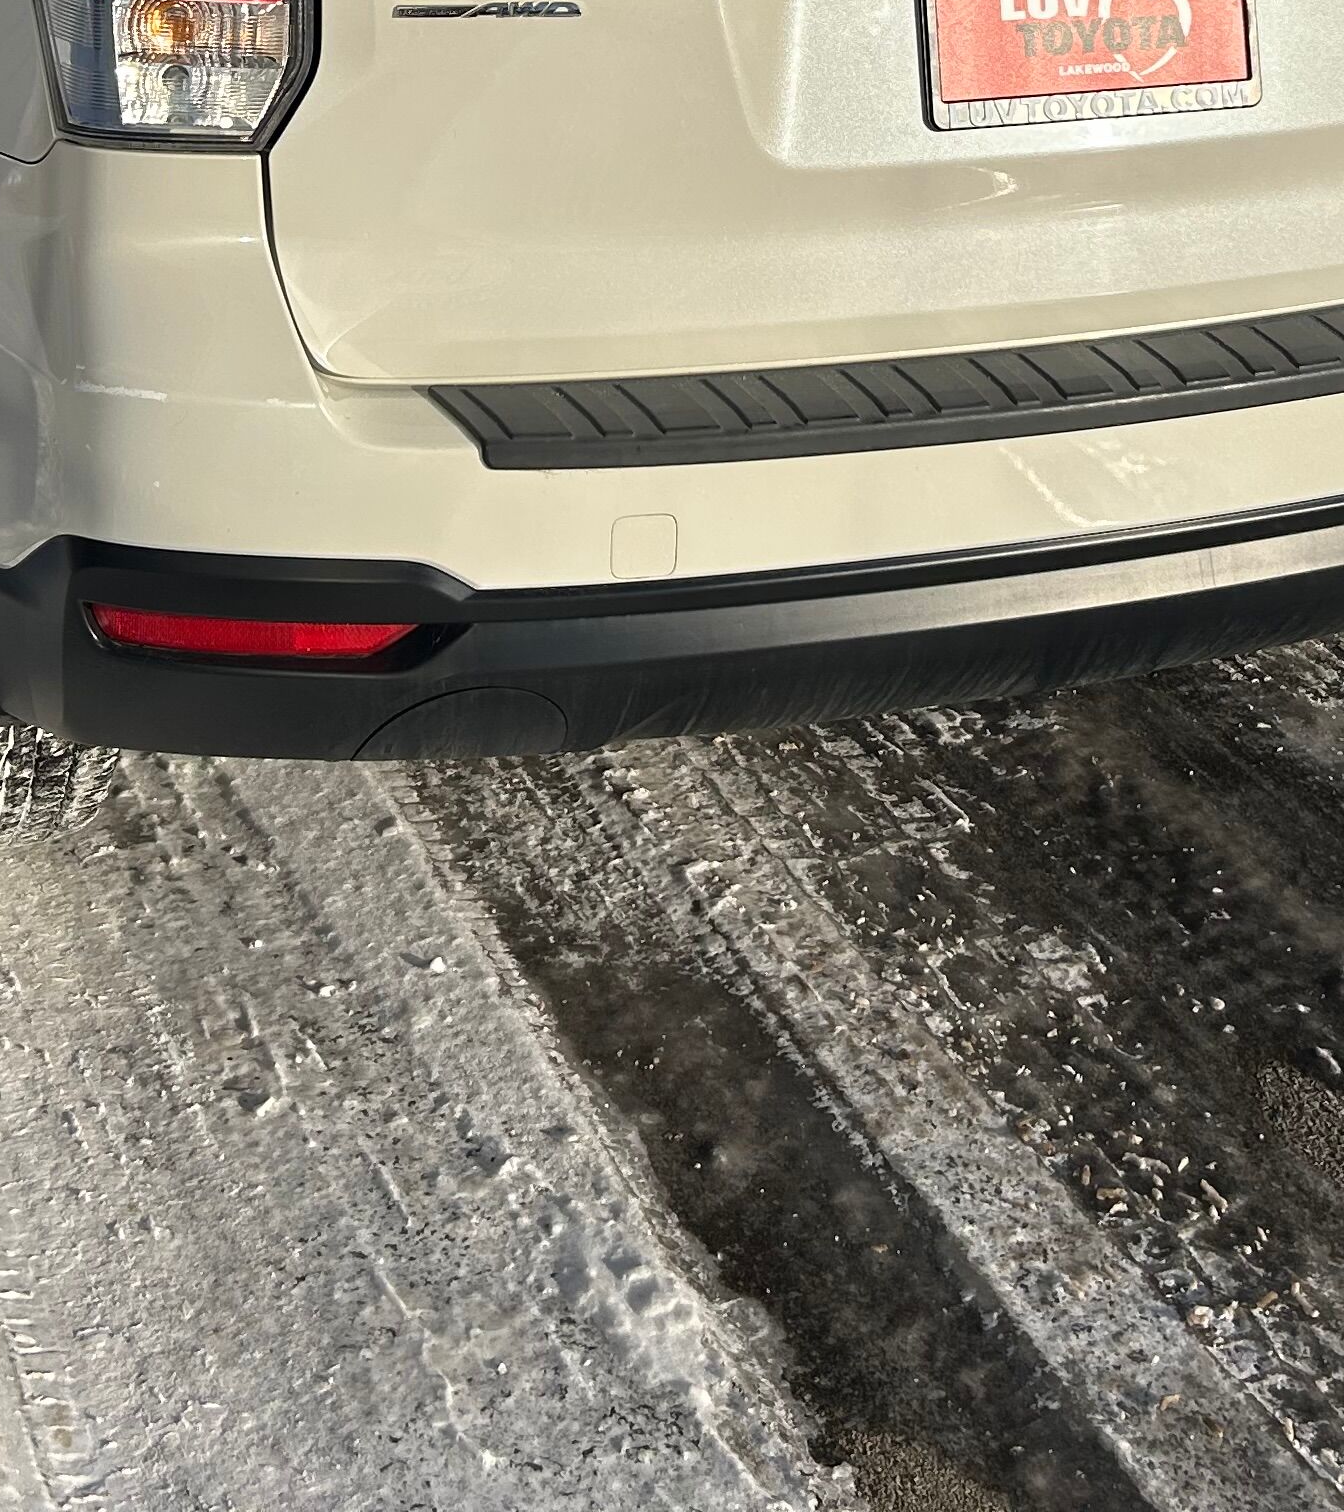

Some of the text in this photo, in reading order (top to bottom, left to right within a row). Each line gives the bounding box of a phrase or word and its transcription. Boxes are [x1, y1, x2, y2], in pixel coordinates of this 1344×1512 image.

[460, 1, 582, 19] AWD
[1016, 14, 1188, 58] TOYOTA
[1058, 62, 1131, 77] LAKEWOOD
